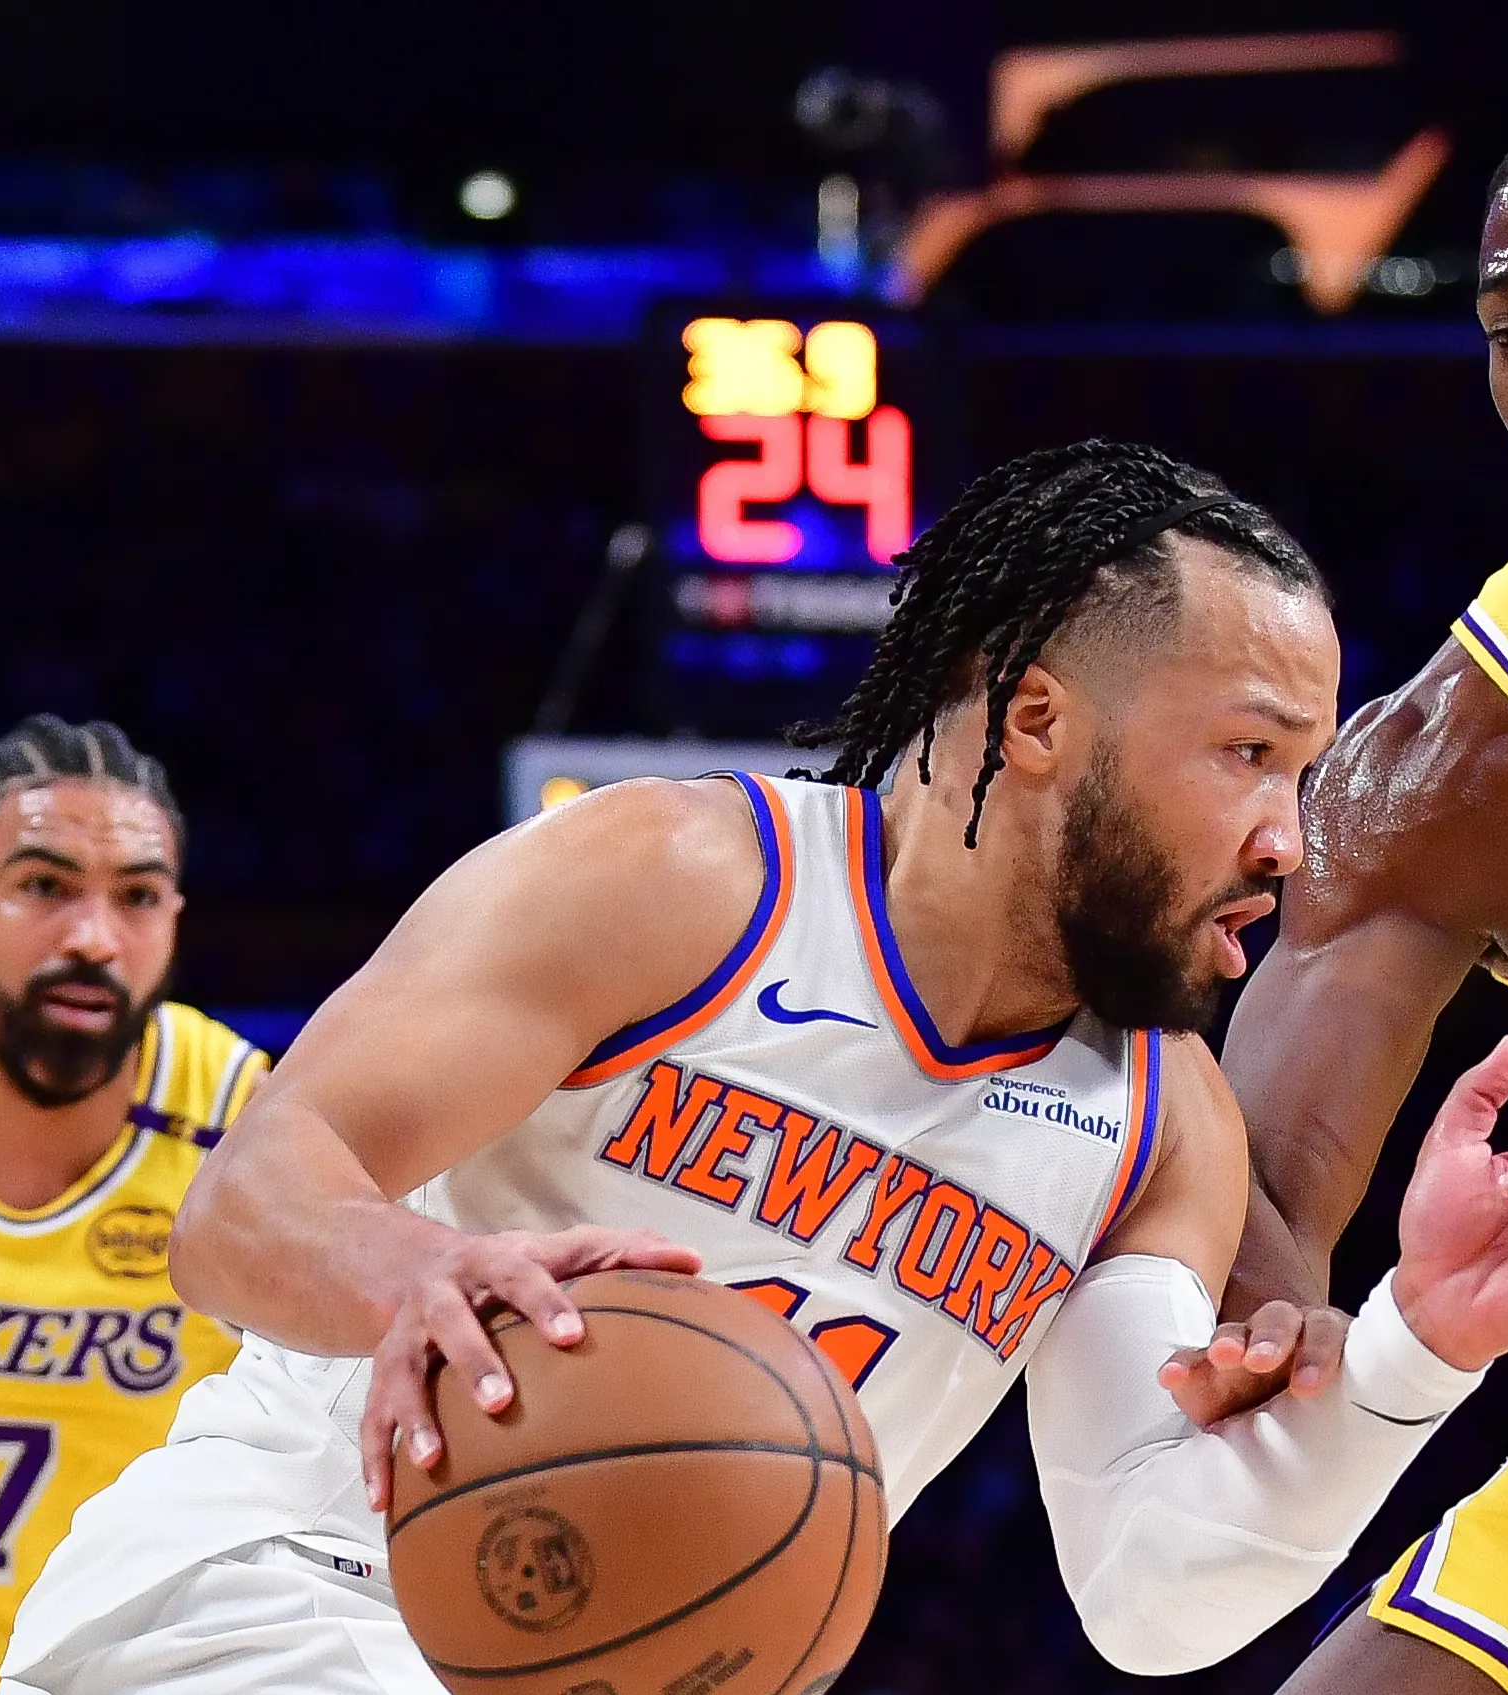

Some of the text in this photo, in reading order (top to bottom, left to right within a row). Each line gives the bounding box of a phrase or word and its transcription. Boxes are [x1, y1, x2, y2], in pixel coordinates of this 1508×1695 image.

[699, 405, 911, 565] 24
[989, 1076, 1067, 1099] experience
[983, 1091, 1122, 1144] abu dhabi
